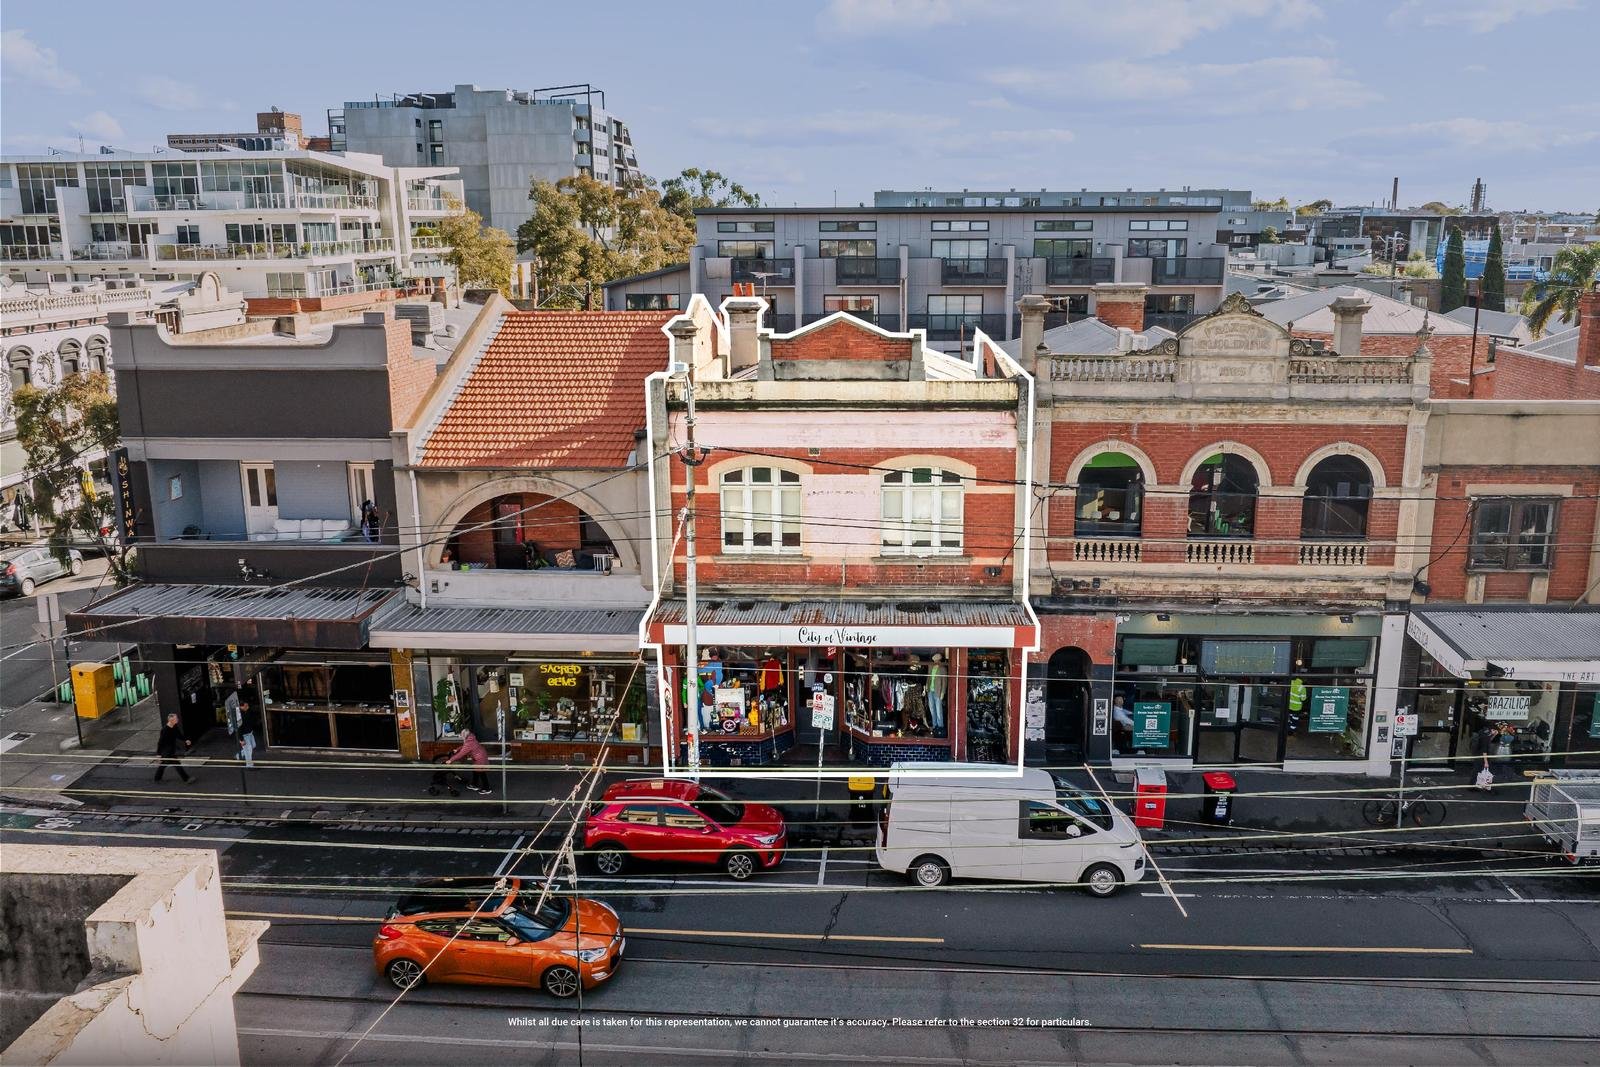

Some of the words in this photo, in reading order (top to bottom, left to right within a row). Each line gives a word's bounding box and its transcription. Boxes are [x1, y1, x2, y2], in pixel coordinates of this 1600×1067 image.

[121, 480, 135, 538] SHINWA
[798, 627, 822, 644] City
[825, 635, 834, 643] of
[834, 626, 878, 645] Vintage
[540, 664, 582, 675] SACRED
[547, 677, 577, 687] GEMS
[1562, 672, 1576, 681] THE
[1580, 672, 1595, 682] ART
[1488, 697, 1530, 710] BRAZILICA
